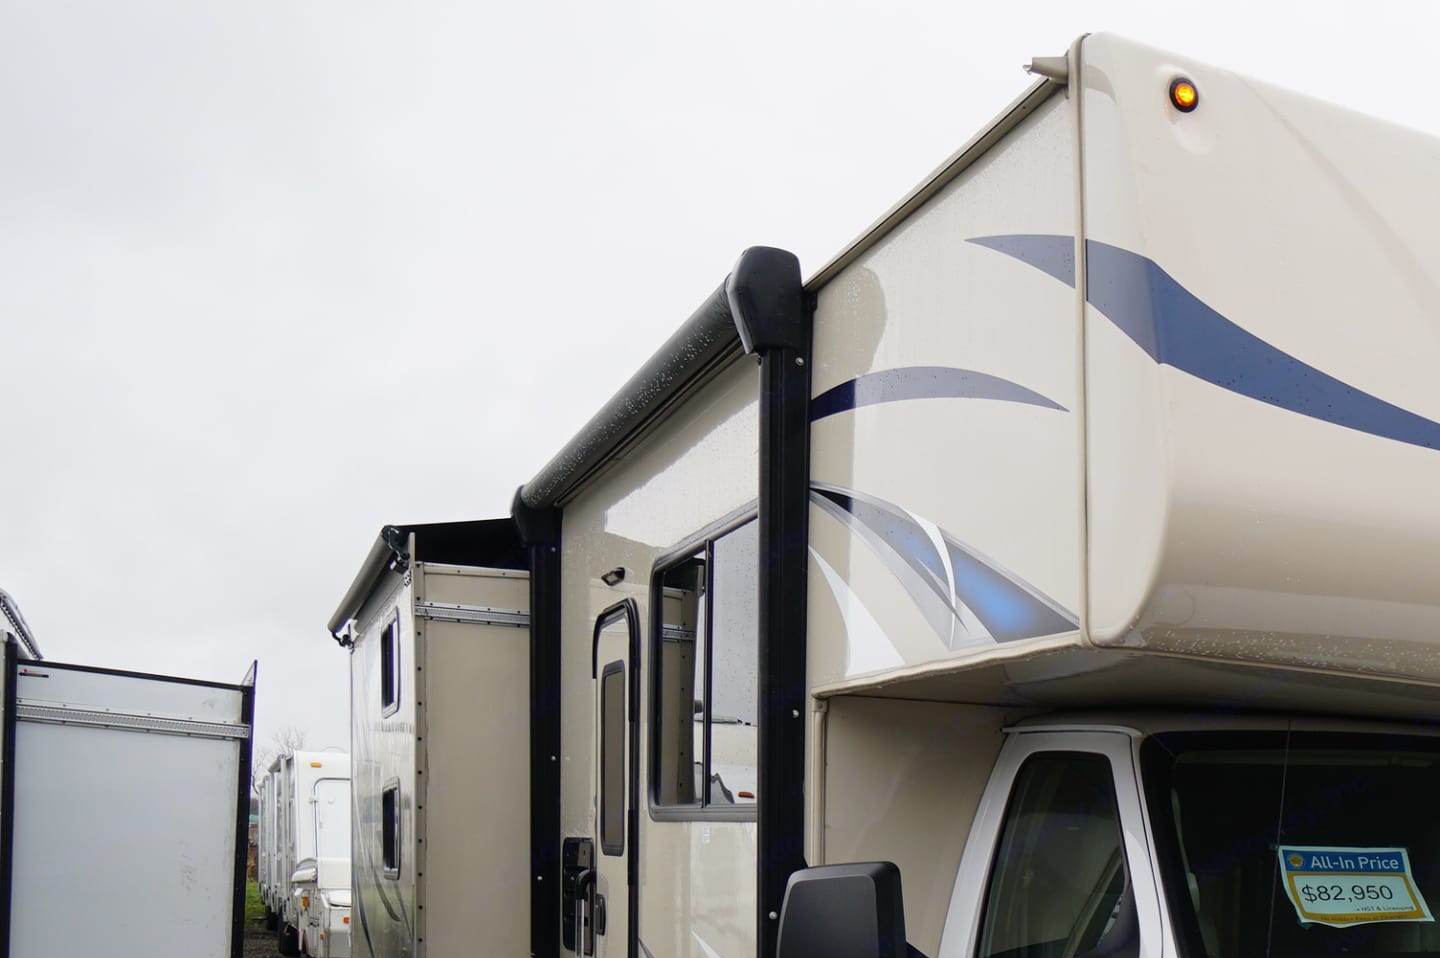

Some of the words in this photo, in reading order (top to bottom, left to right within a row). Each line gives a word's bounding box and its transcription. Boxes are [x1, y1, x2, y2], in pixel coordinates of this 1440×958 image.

[1310, 855, 1355, 870] All-In
[1358, 856, 1399, 870] Price
[1301, 883, 1393, 903] $82,950
